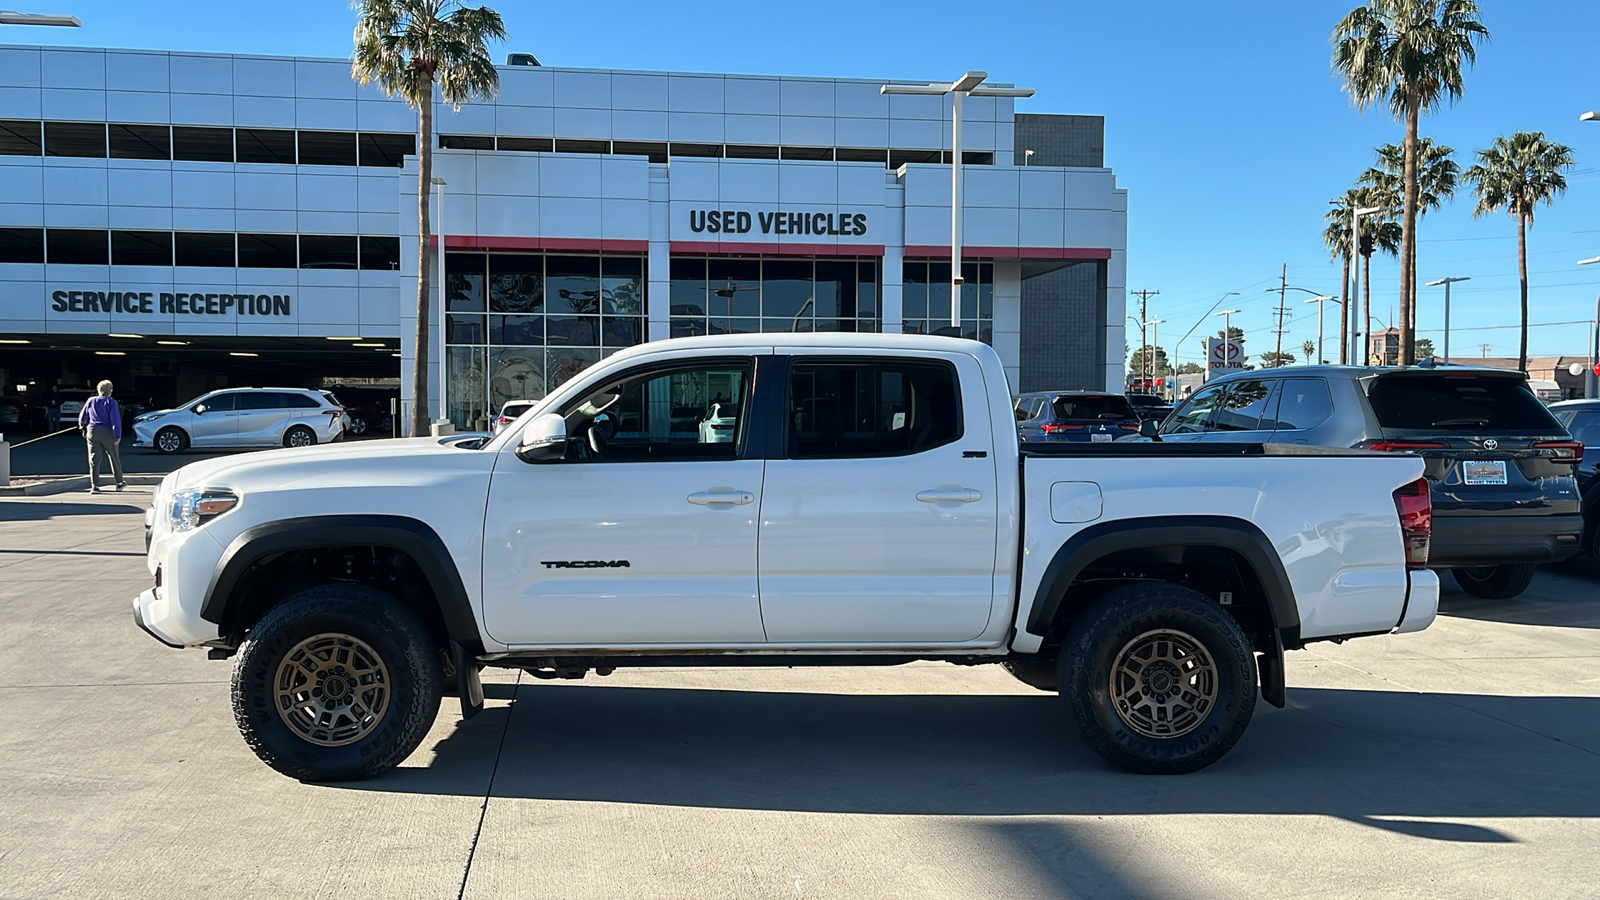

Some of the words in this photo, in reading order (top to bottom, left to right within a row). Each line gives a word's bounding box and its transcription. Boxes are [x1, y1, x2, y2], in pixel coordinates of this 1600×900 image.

[690, 210, 751, 233] USED
[758, 212, 867, 236] VEHICLES
[52, 291, 153, 313] SERVICE
[159, 293, 290, 316] RECEPTION
[1210, 361, 1243, 369] TOYOTA
[540, 560, 630, 569] TACOMA
